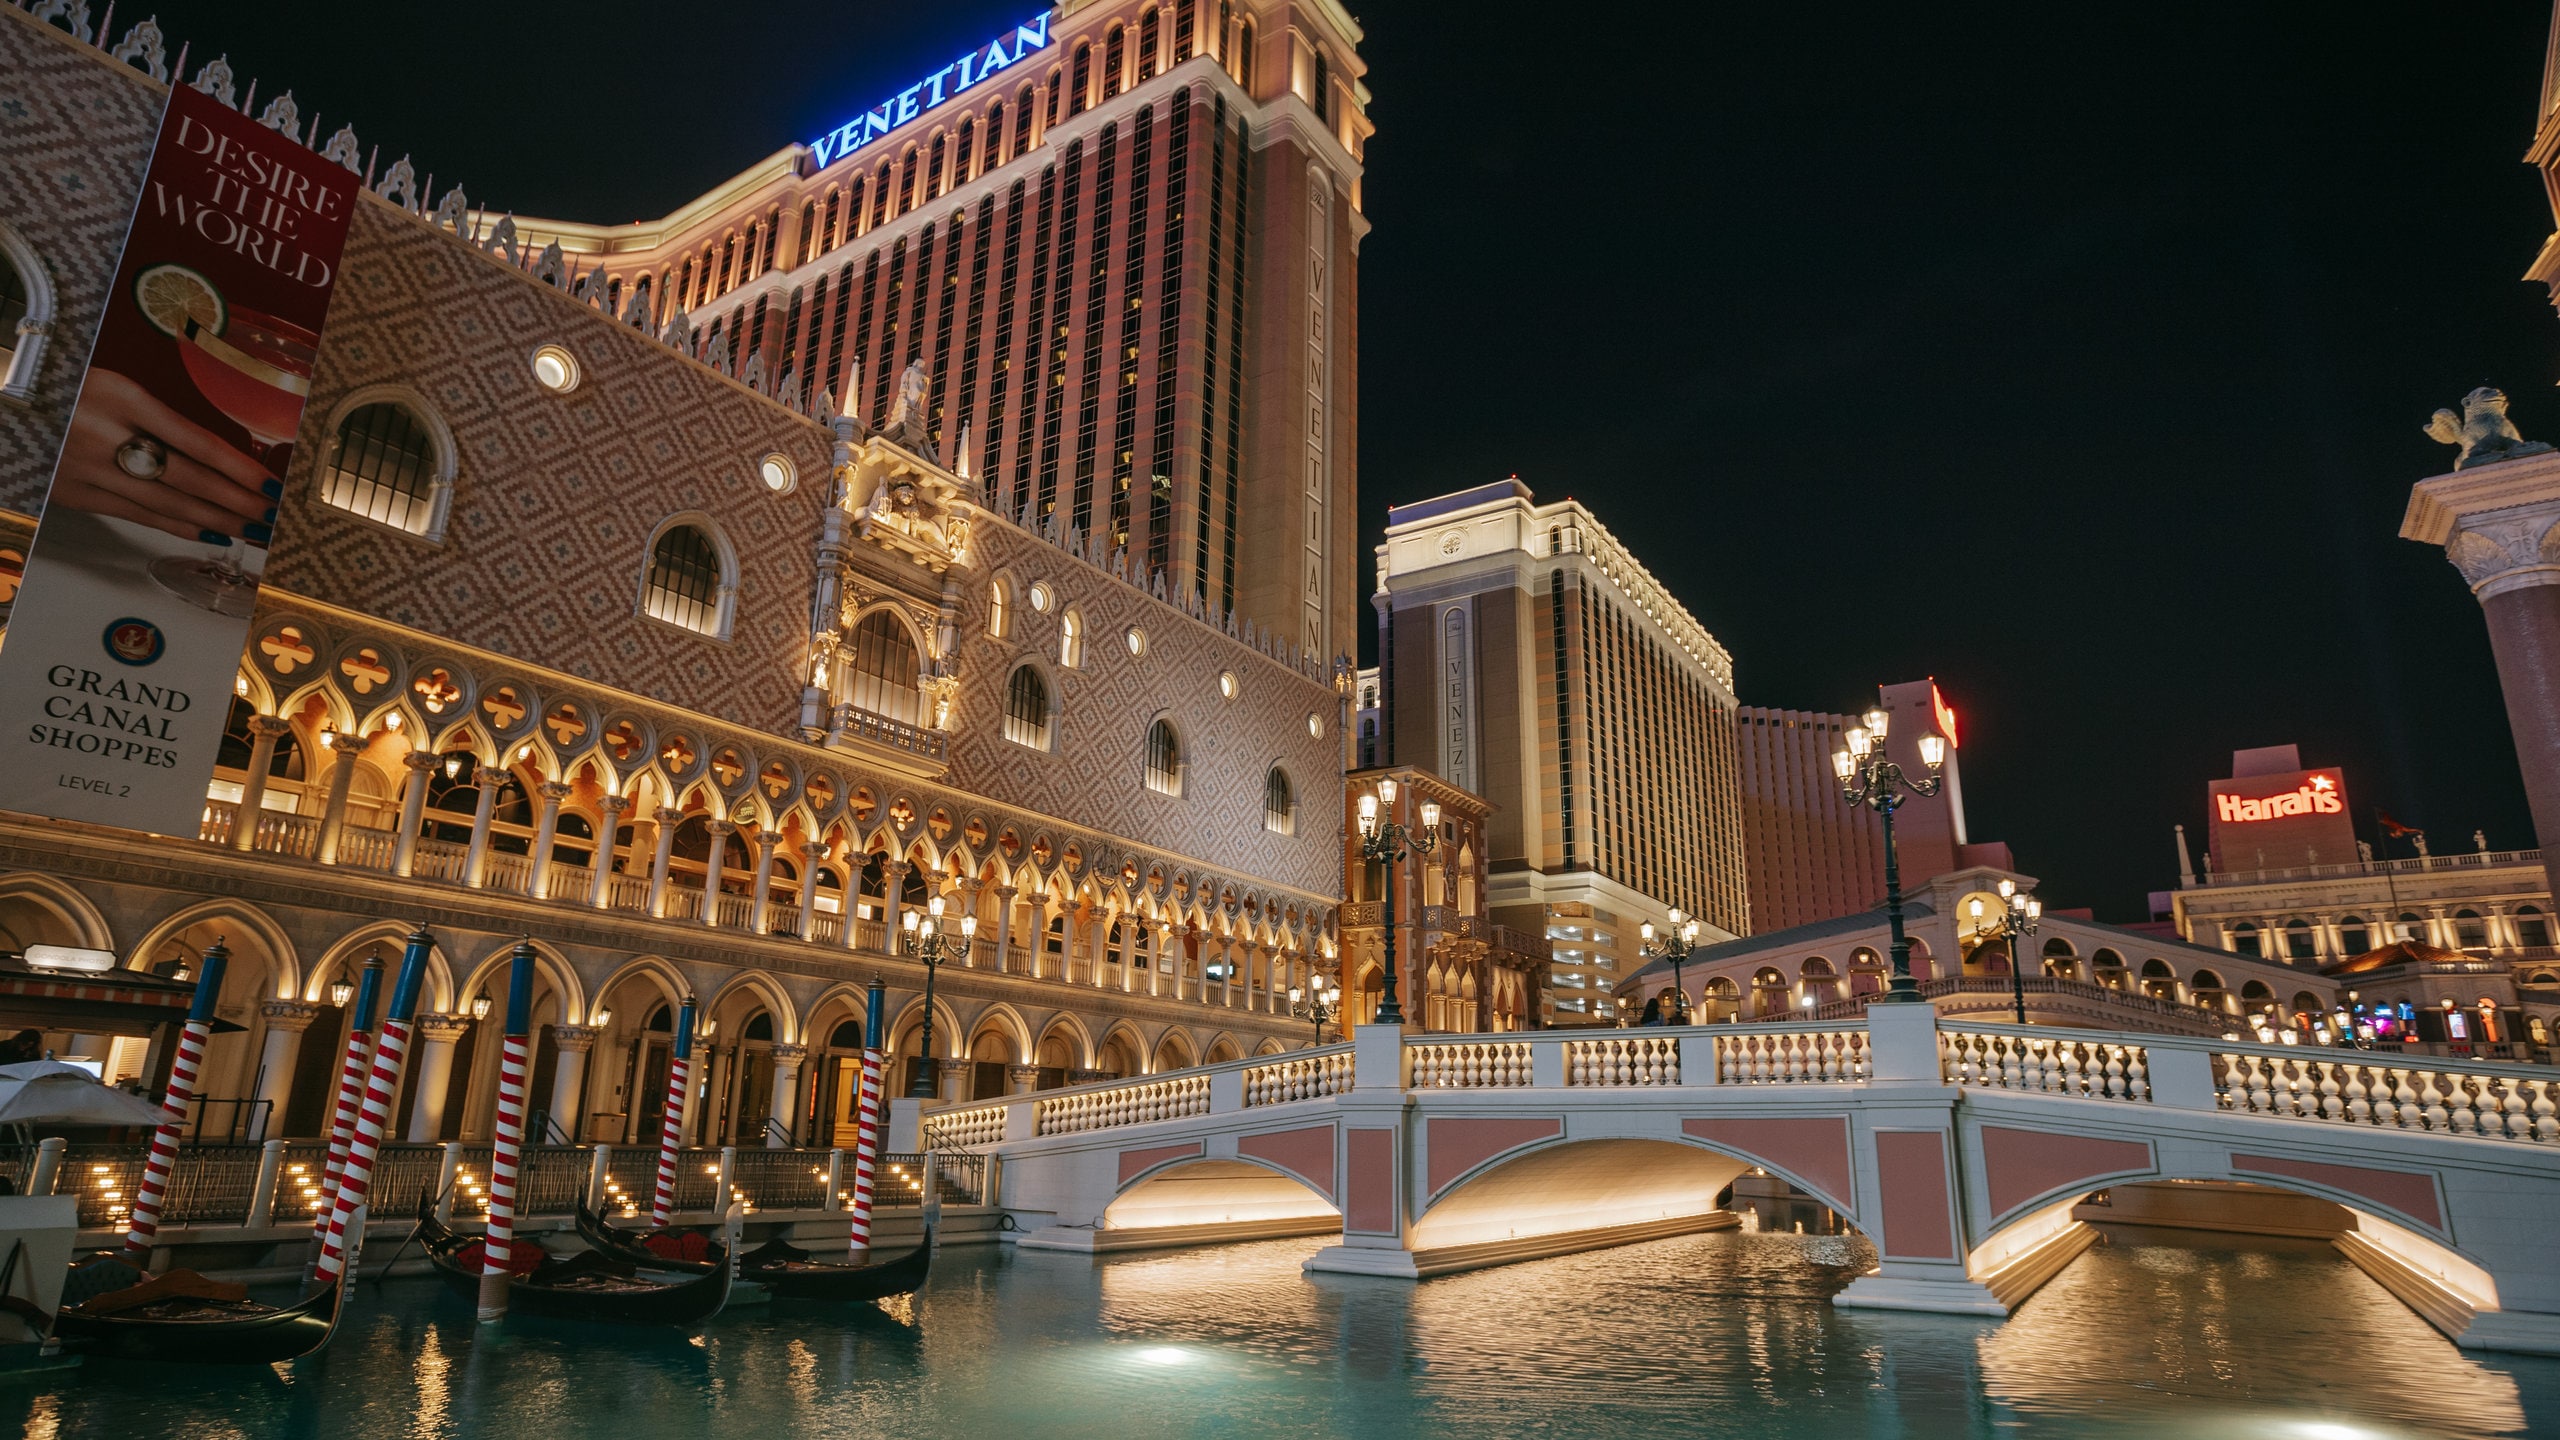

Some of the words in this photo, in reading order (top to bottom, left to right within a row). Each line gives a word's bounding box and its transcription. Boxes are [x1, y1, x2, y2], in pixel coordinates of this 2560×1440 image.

[810, 10, 1052, 170] VENETIAN
[176, 114, 343, 222] DESIRE
[205, 166, 302, 240] THE
[153, 180, 331, 288] WORLD
[1308, 260, 1323, 652] VENETIAN
[44, 695, 179, 742] CANAL
[47, 664, 191, 713] GRAND
[29, 723, 178, 769] SHOPPES
[58, 774, 114, 796] LEVEL
[119, 784, 131, 798] 2
[34, 952, 76, 962] GONDOLA
